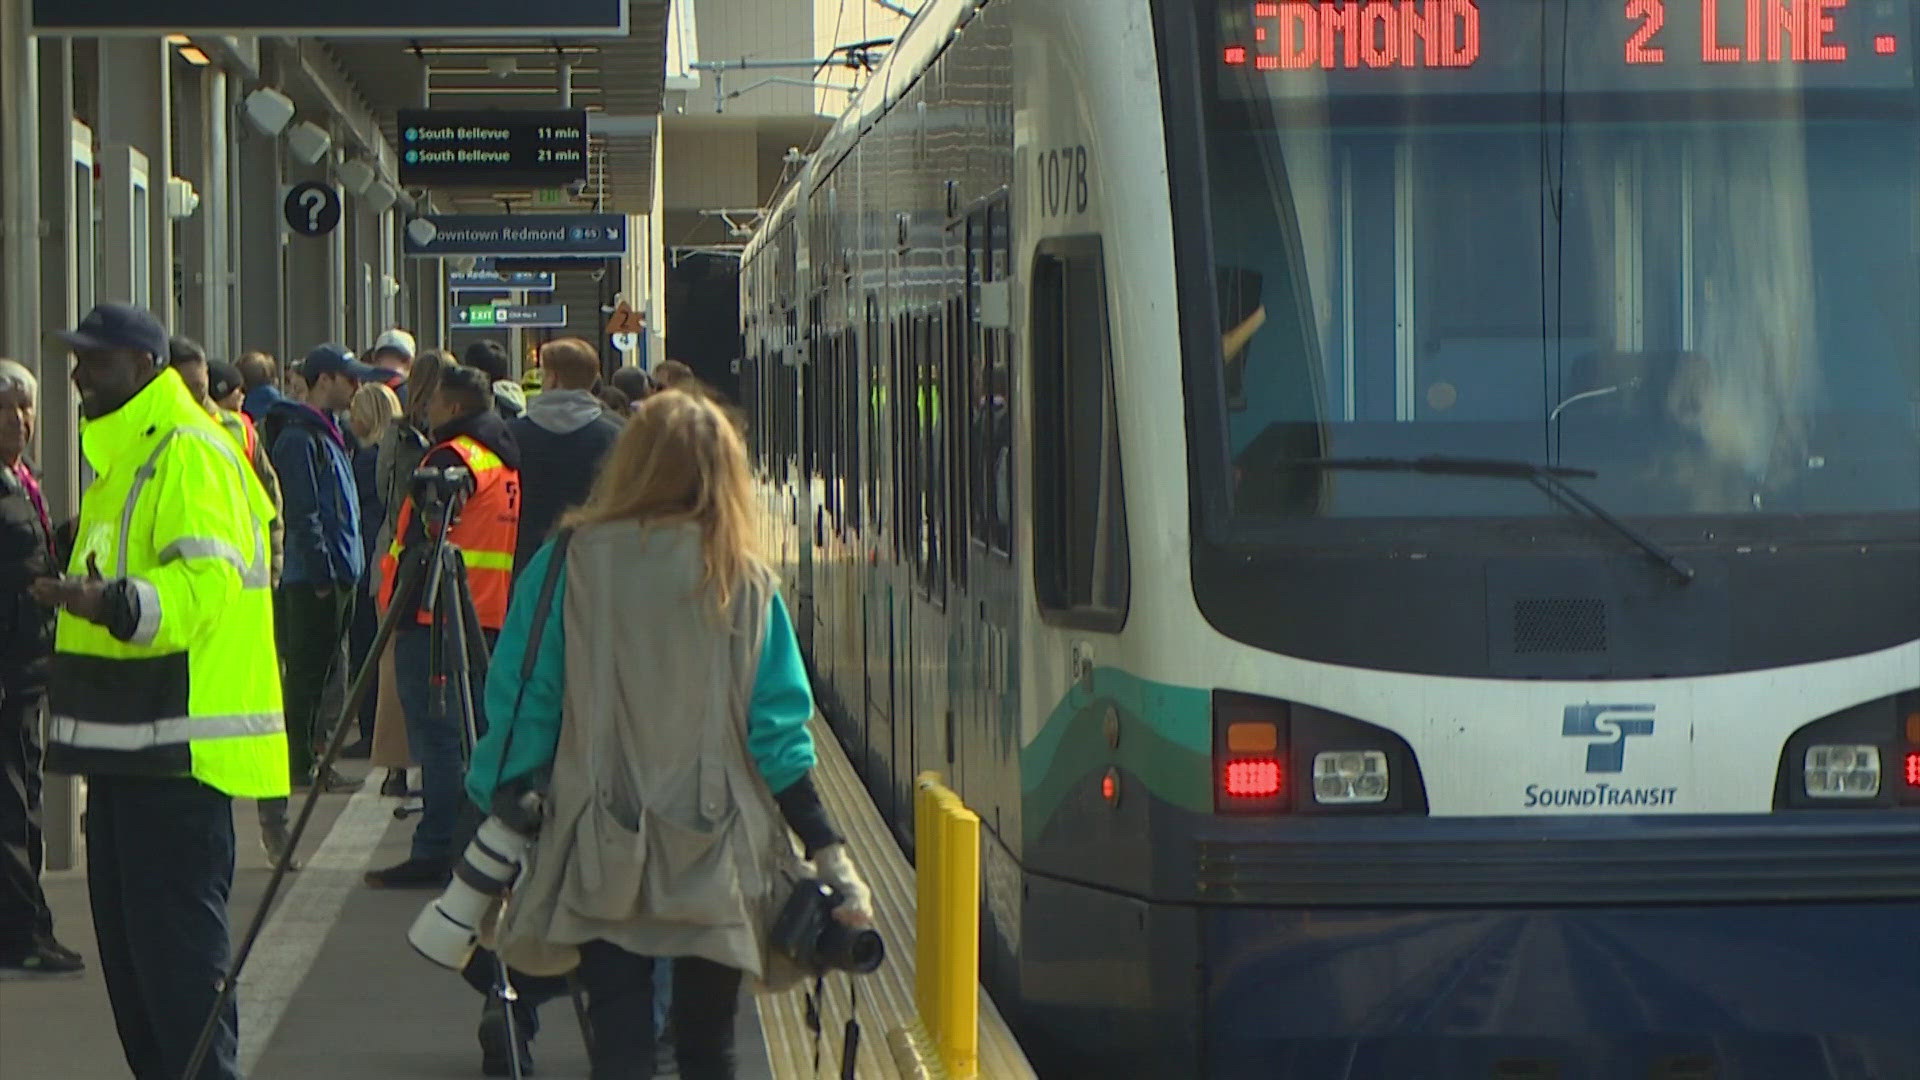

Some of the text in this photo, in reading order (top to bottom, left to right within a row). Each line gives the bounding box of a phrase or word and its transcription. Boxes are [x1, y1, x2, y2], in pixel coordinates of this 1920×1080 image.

[1624, 0, 1665, 63] 2
[1702, 0, 1847, 62] LINE
[419, 127, 454, 140] South
[457, 127, 510, 140] Bellevue
[538, 128, 551, 139] 11
[555, 127, 580, 139] min
[419, 150, 454, 163] South
[457, 150, 511, 163] Bellevue
[537, 150, 551, 162] 21
[555, 150, 580, 162] min
[1039, 144, 1088, 217] 107B
[436, 229, 499, 241] owntown
[502, 227, 566, 240] Redmond
[471, 311, 492, 319] EXIT
[619, 311, 629, 328] 2
